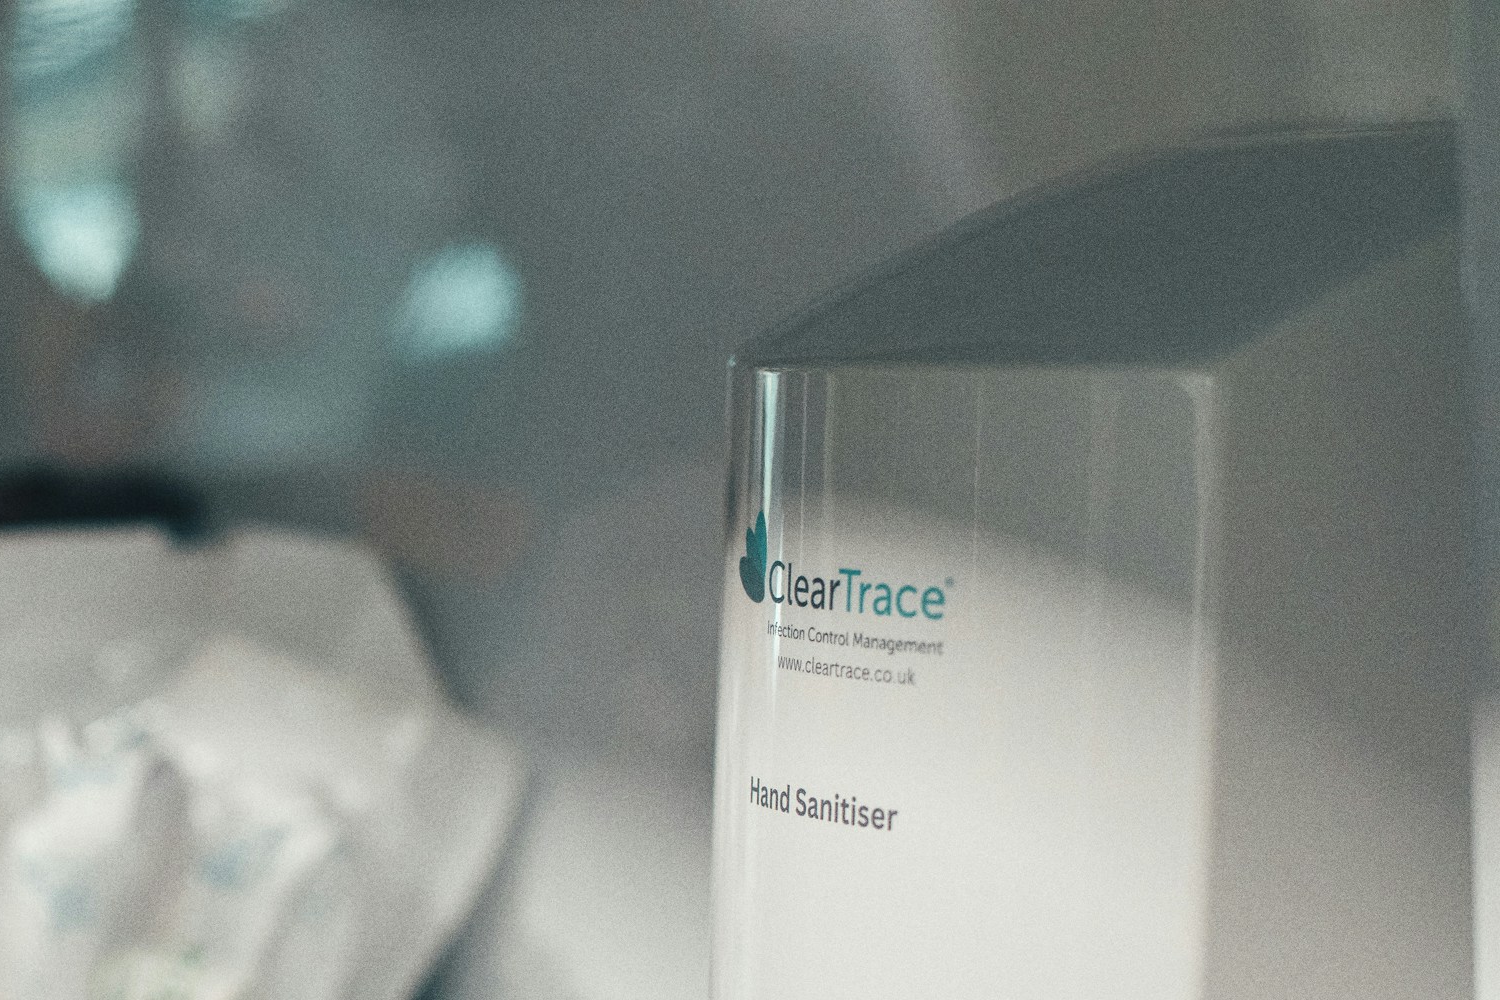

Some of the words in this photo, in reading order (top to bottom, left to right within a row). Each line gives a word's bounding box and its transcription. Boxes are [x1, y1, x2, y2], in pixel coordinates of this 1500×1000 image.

[767, 620, 805, 641] Infection
[807, 626, 849, 647] Control
[852, 632, 945, 655] Management
[777, 654, 915, 686] www.cleartrace.co.uk
[750, 776, 790, 813] Hand
[795, 787, 898, 831] Sanitiser
